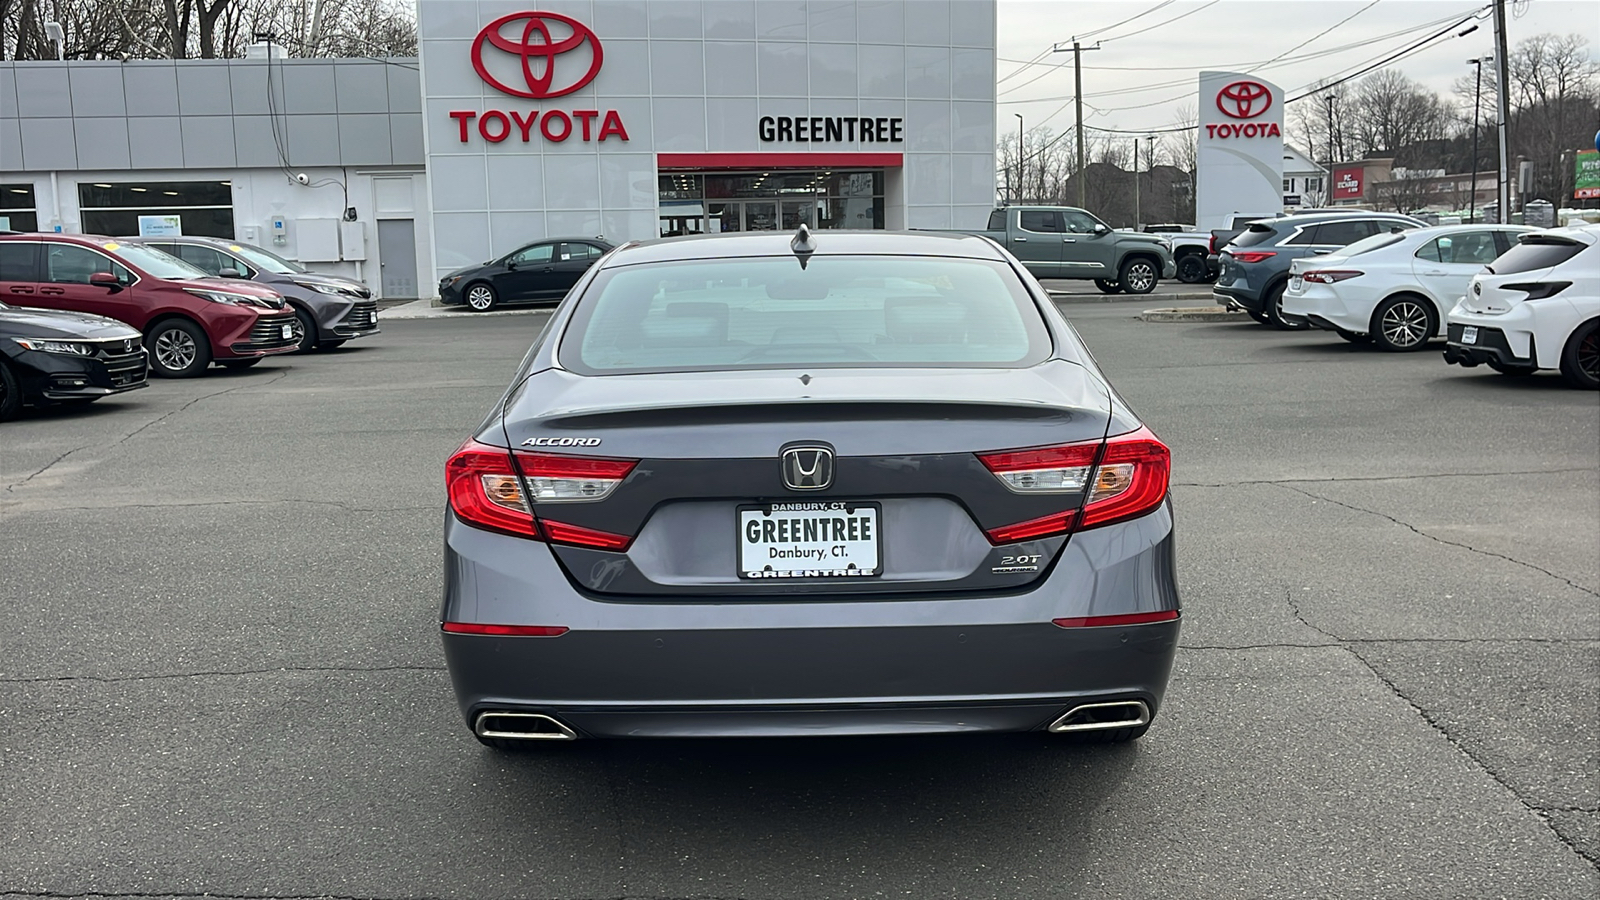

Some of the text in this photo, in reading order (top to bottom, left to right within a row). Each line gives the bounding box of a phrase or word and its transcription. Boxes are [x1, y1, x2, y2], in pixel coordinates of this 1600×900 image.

[449, 109, 630, 143] TOYOTA
[758, 116, 904, 142] GREENTREE
[1205, 122, 1281, 139] TOYOTA
[521, 437, 602, 447] ACCORD
[771, 502, 846, 512] DANBURY, CT
[746, 517, 871, 544] GREENTREE
[769, 545, 848, 561] Danbury, CT.
[1001, 554, 1042, 565] 2.0T
[747, 569, 875, 578] GREENTREE
